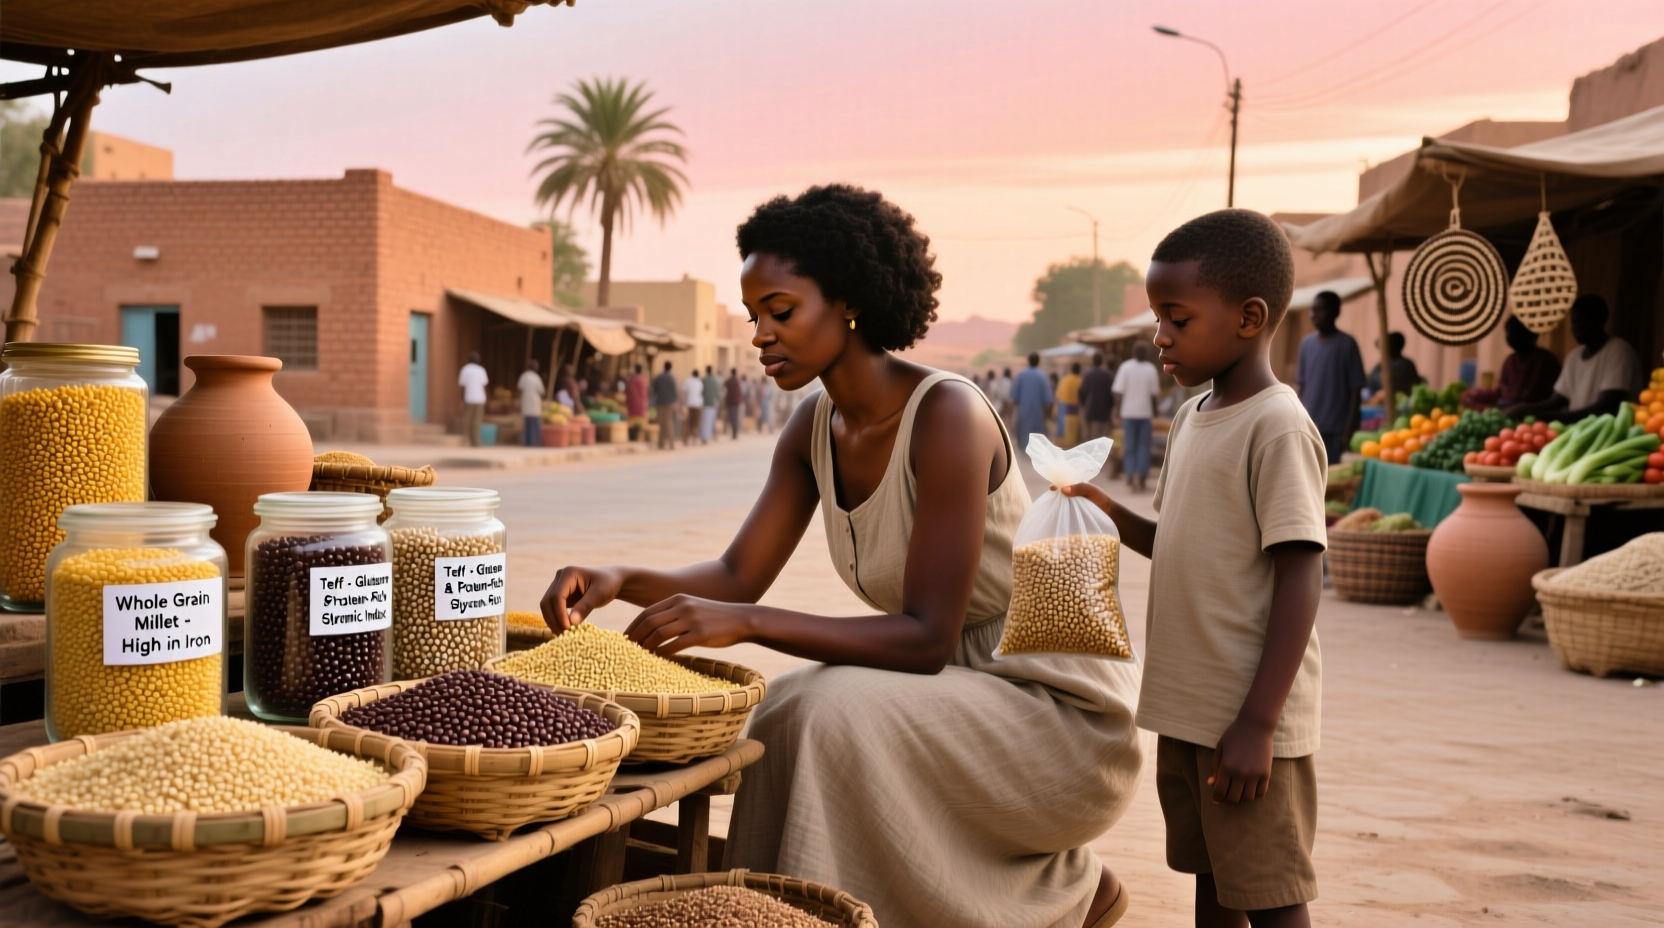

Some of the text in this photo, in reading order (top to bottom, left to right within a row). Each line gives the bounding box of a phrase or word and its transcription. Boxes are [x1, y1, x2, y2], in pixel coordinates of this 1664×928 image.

[319, 576, 344, 590] Teff
[115, 590, 210, 611] Whole Grain
[135, 613, 179, 631] Millet
[122, 634, 211, 657] High in Iron
